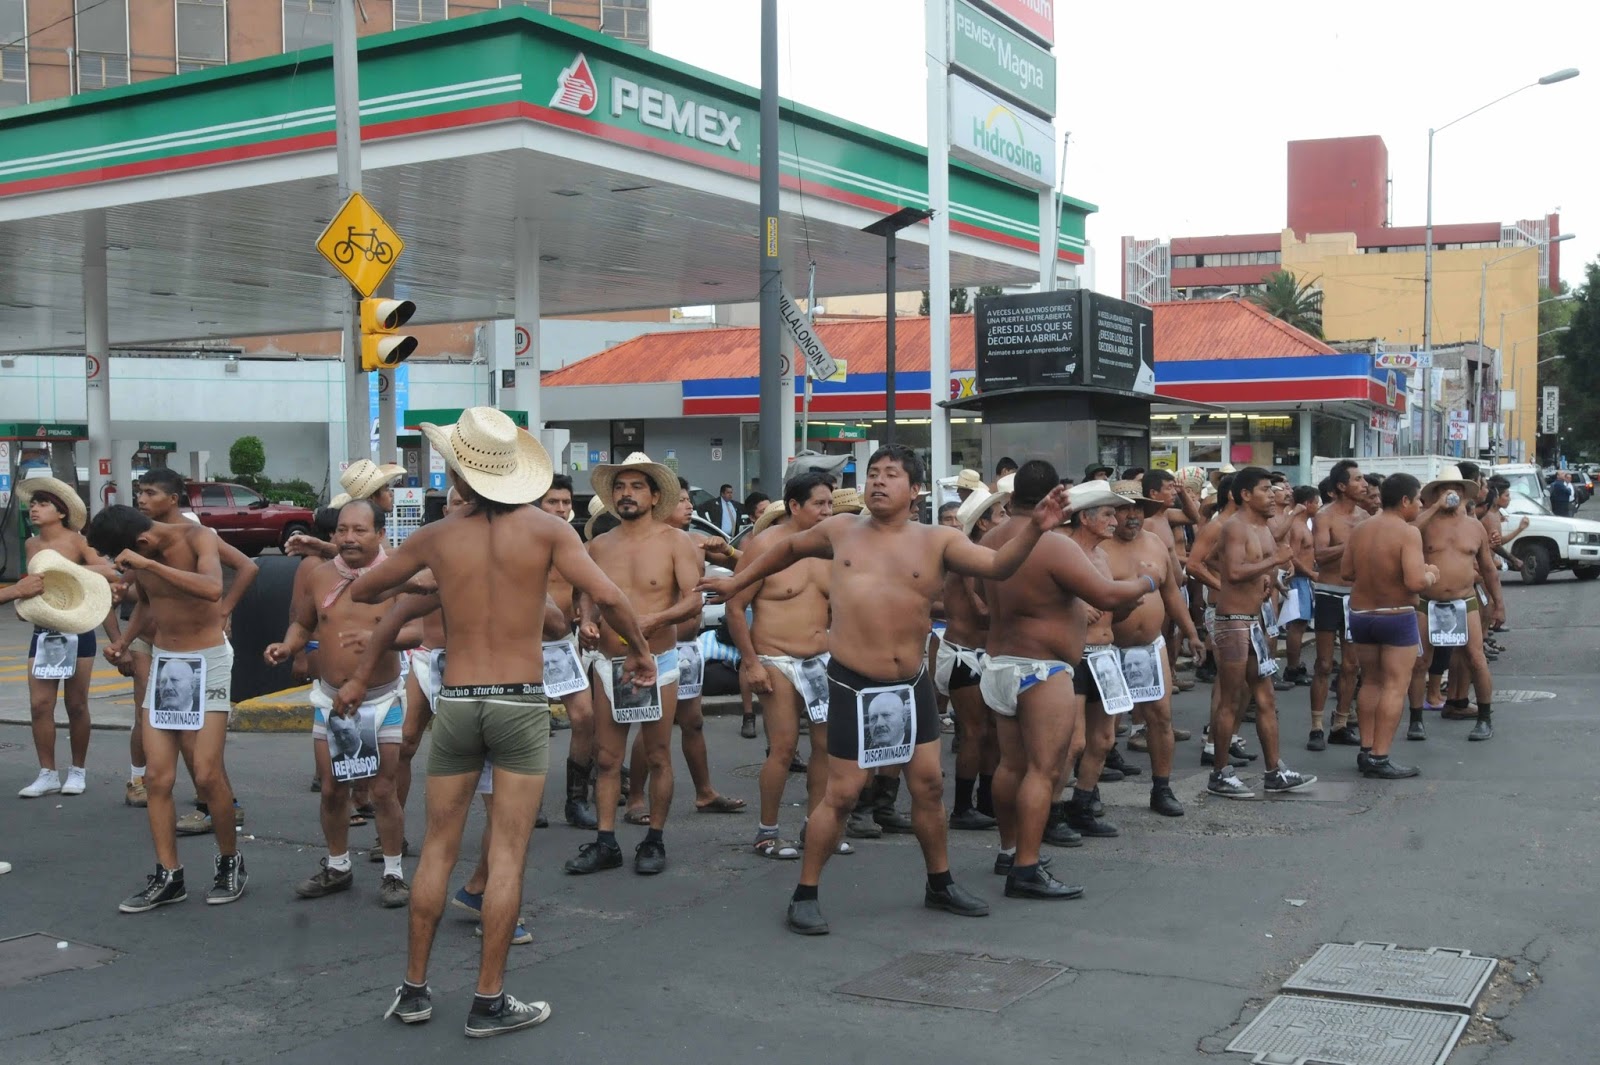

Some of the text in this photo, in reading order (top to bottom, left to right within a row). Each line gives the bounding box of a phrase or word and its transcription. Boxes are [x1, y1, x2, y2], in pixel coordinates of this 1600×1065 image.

[956, 13, 1044, 90] PEMEX Magna
[611, 76, 741, 151] PEMEX
[973, 115, 1042, 175] Hidrosina
[1049, 304, 1072, 312] OFRECE
[1000, 315, 1025, 323] PUERTA
[1025, 312, 1073, 321] ENTREABIERTA.
[780, 295, 826, 366] VILLALONGIN
[988, 321, 1073, 337] ¿ERES DE LOS QUE SE
[987, 332, 1073, 346] DECIDEN A ABRIRLA?
[1381, 354, 1412, 365] extra
[1420, 356, 1430, 364] 24
[47, 428, 72, 436] PEMEX
[1431, 632, 1466, 645] REPRESOR
[35, 665, 73, 678] REPRESOR
[547, 678, 586, 694] DISCRIMINADOR
[1130, 686, 1162, 699] SCRIMINADOR
[155, 711, 200, 726] DISCRIMINADOR
[616, 707, 661, 722] DISCRIMINADOR
[864, 745, 911, 763] DISCRIMINADOR
[334, 755, 378, 779] REPRESOR
